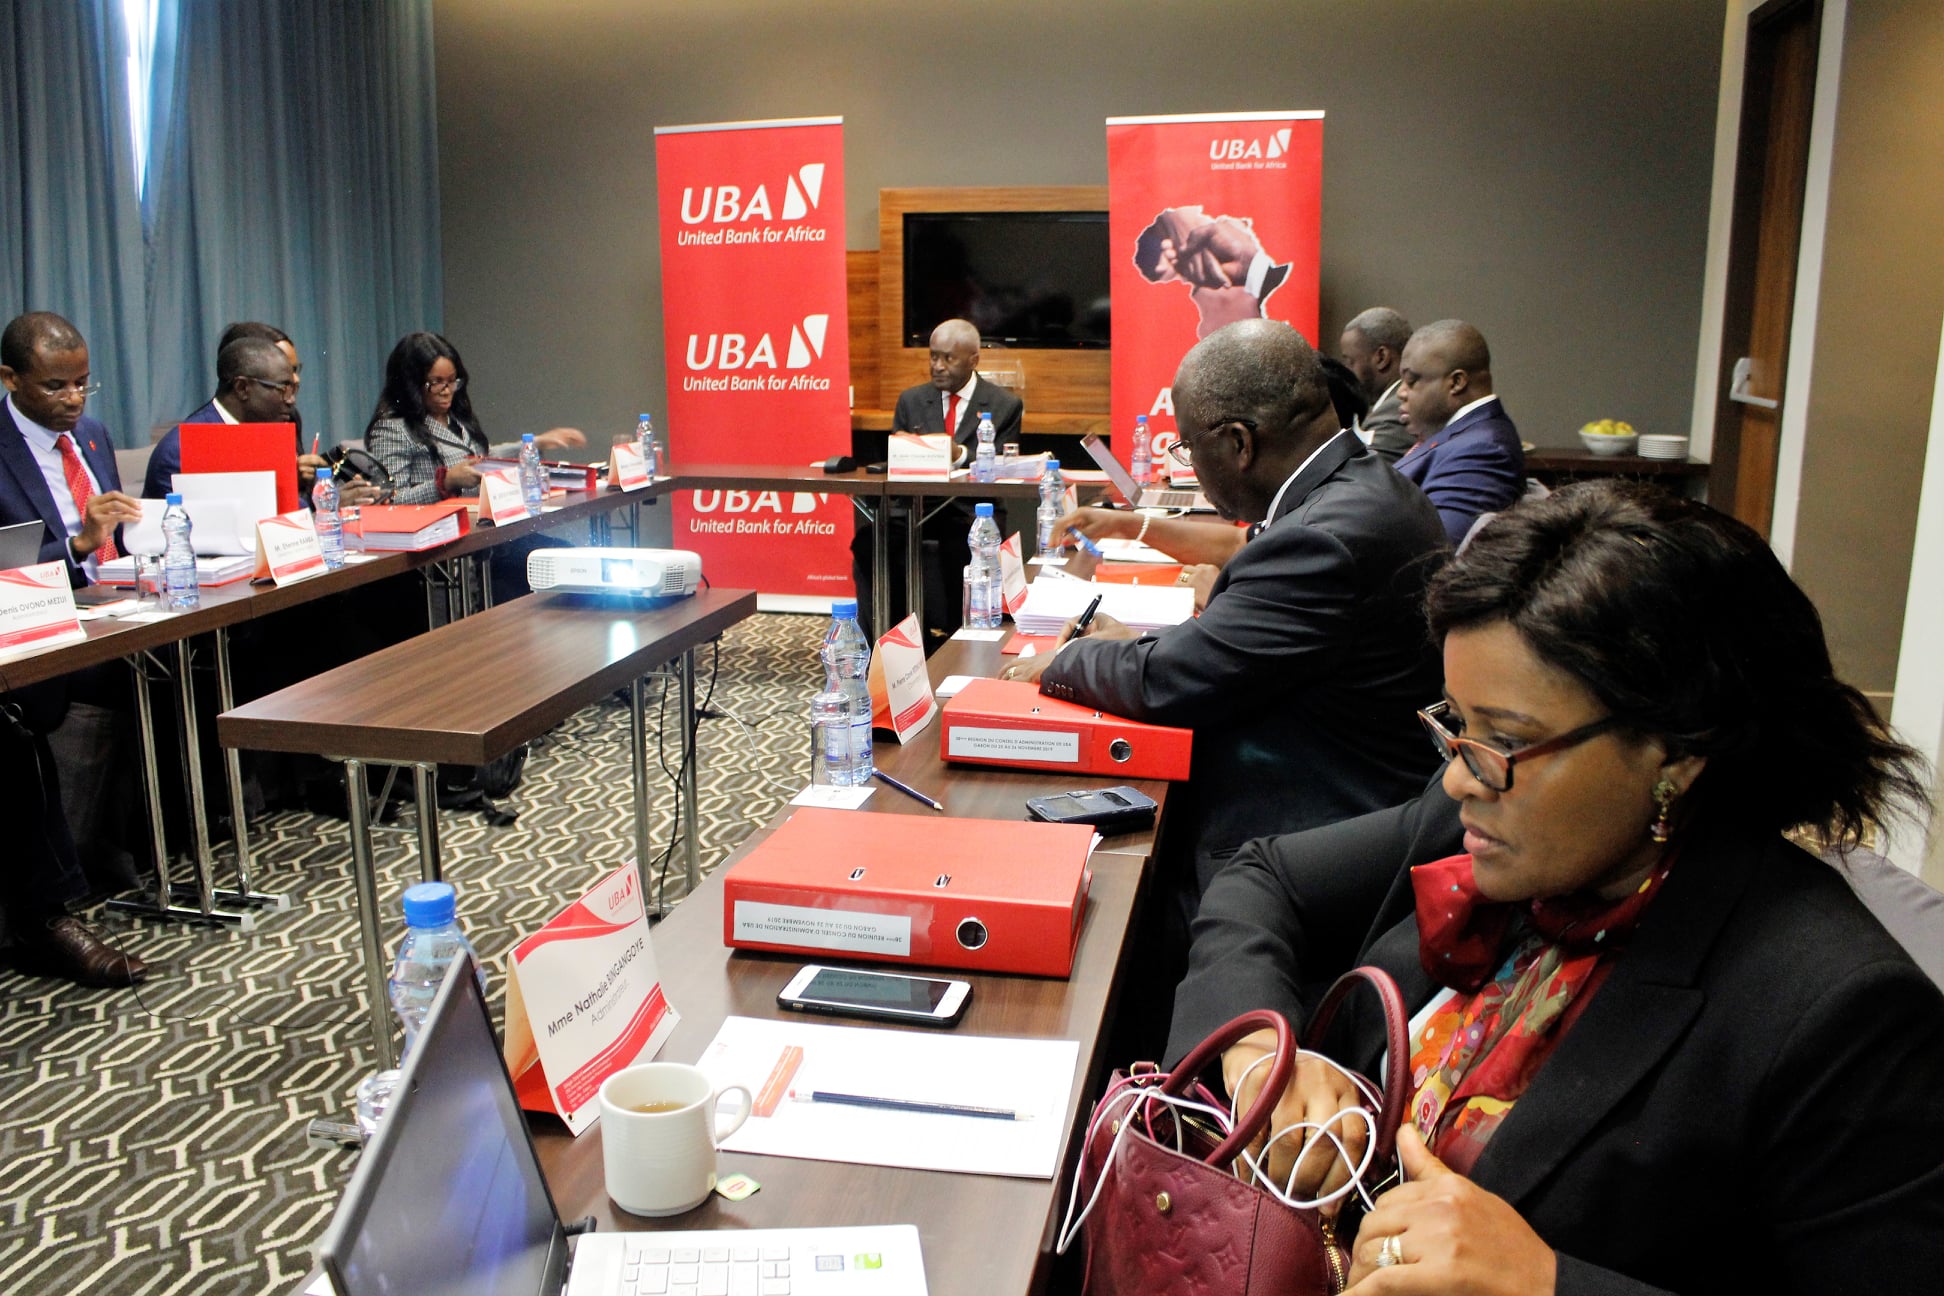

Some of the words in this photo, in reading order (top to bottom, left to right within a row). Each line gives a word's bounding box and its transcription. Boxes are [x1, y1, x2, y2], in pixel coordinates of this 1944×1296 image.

[1210, 138, 1262, 160] UBA
[680, 184, 773, 224] UBA
[677, 229, 724, 246] United
[725, 227, 760, 244] Bank
[763, 226, 783, 243] for
[784, 225, 826, 243] Africa
[686, 333, 778, 371] UBA
[683, 375, 729, 391] United
[730, 375, 765, 391] Bank
[767, 374, 787, 390] for
[788, 374, 830, 391] Africa
[692, 489, 782, 513] UBA
[690, 518, 734, 534] United
[736, 519, 770, 534] Bank
[773, 518, 793, 534] for
[794, 519, 835, 535] Africa
[19, 600, 46, 611] OVONO
[47, 596, 67, 606] MEZUI
[608, 888, 625, 910] UBA
[783, 918, 815, 926] NOVEMBRE
[547, 1011, 574, 1038] Mme
[574, 981, 609, 1016] Nathalie
[606, 937, 644, 985] BINGANGOYE
